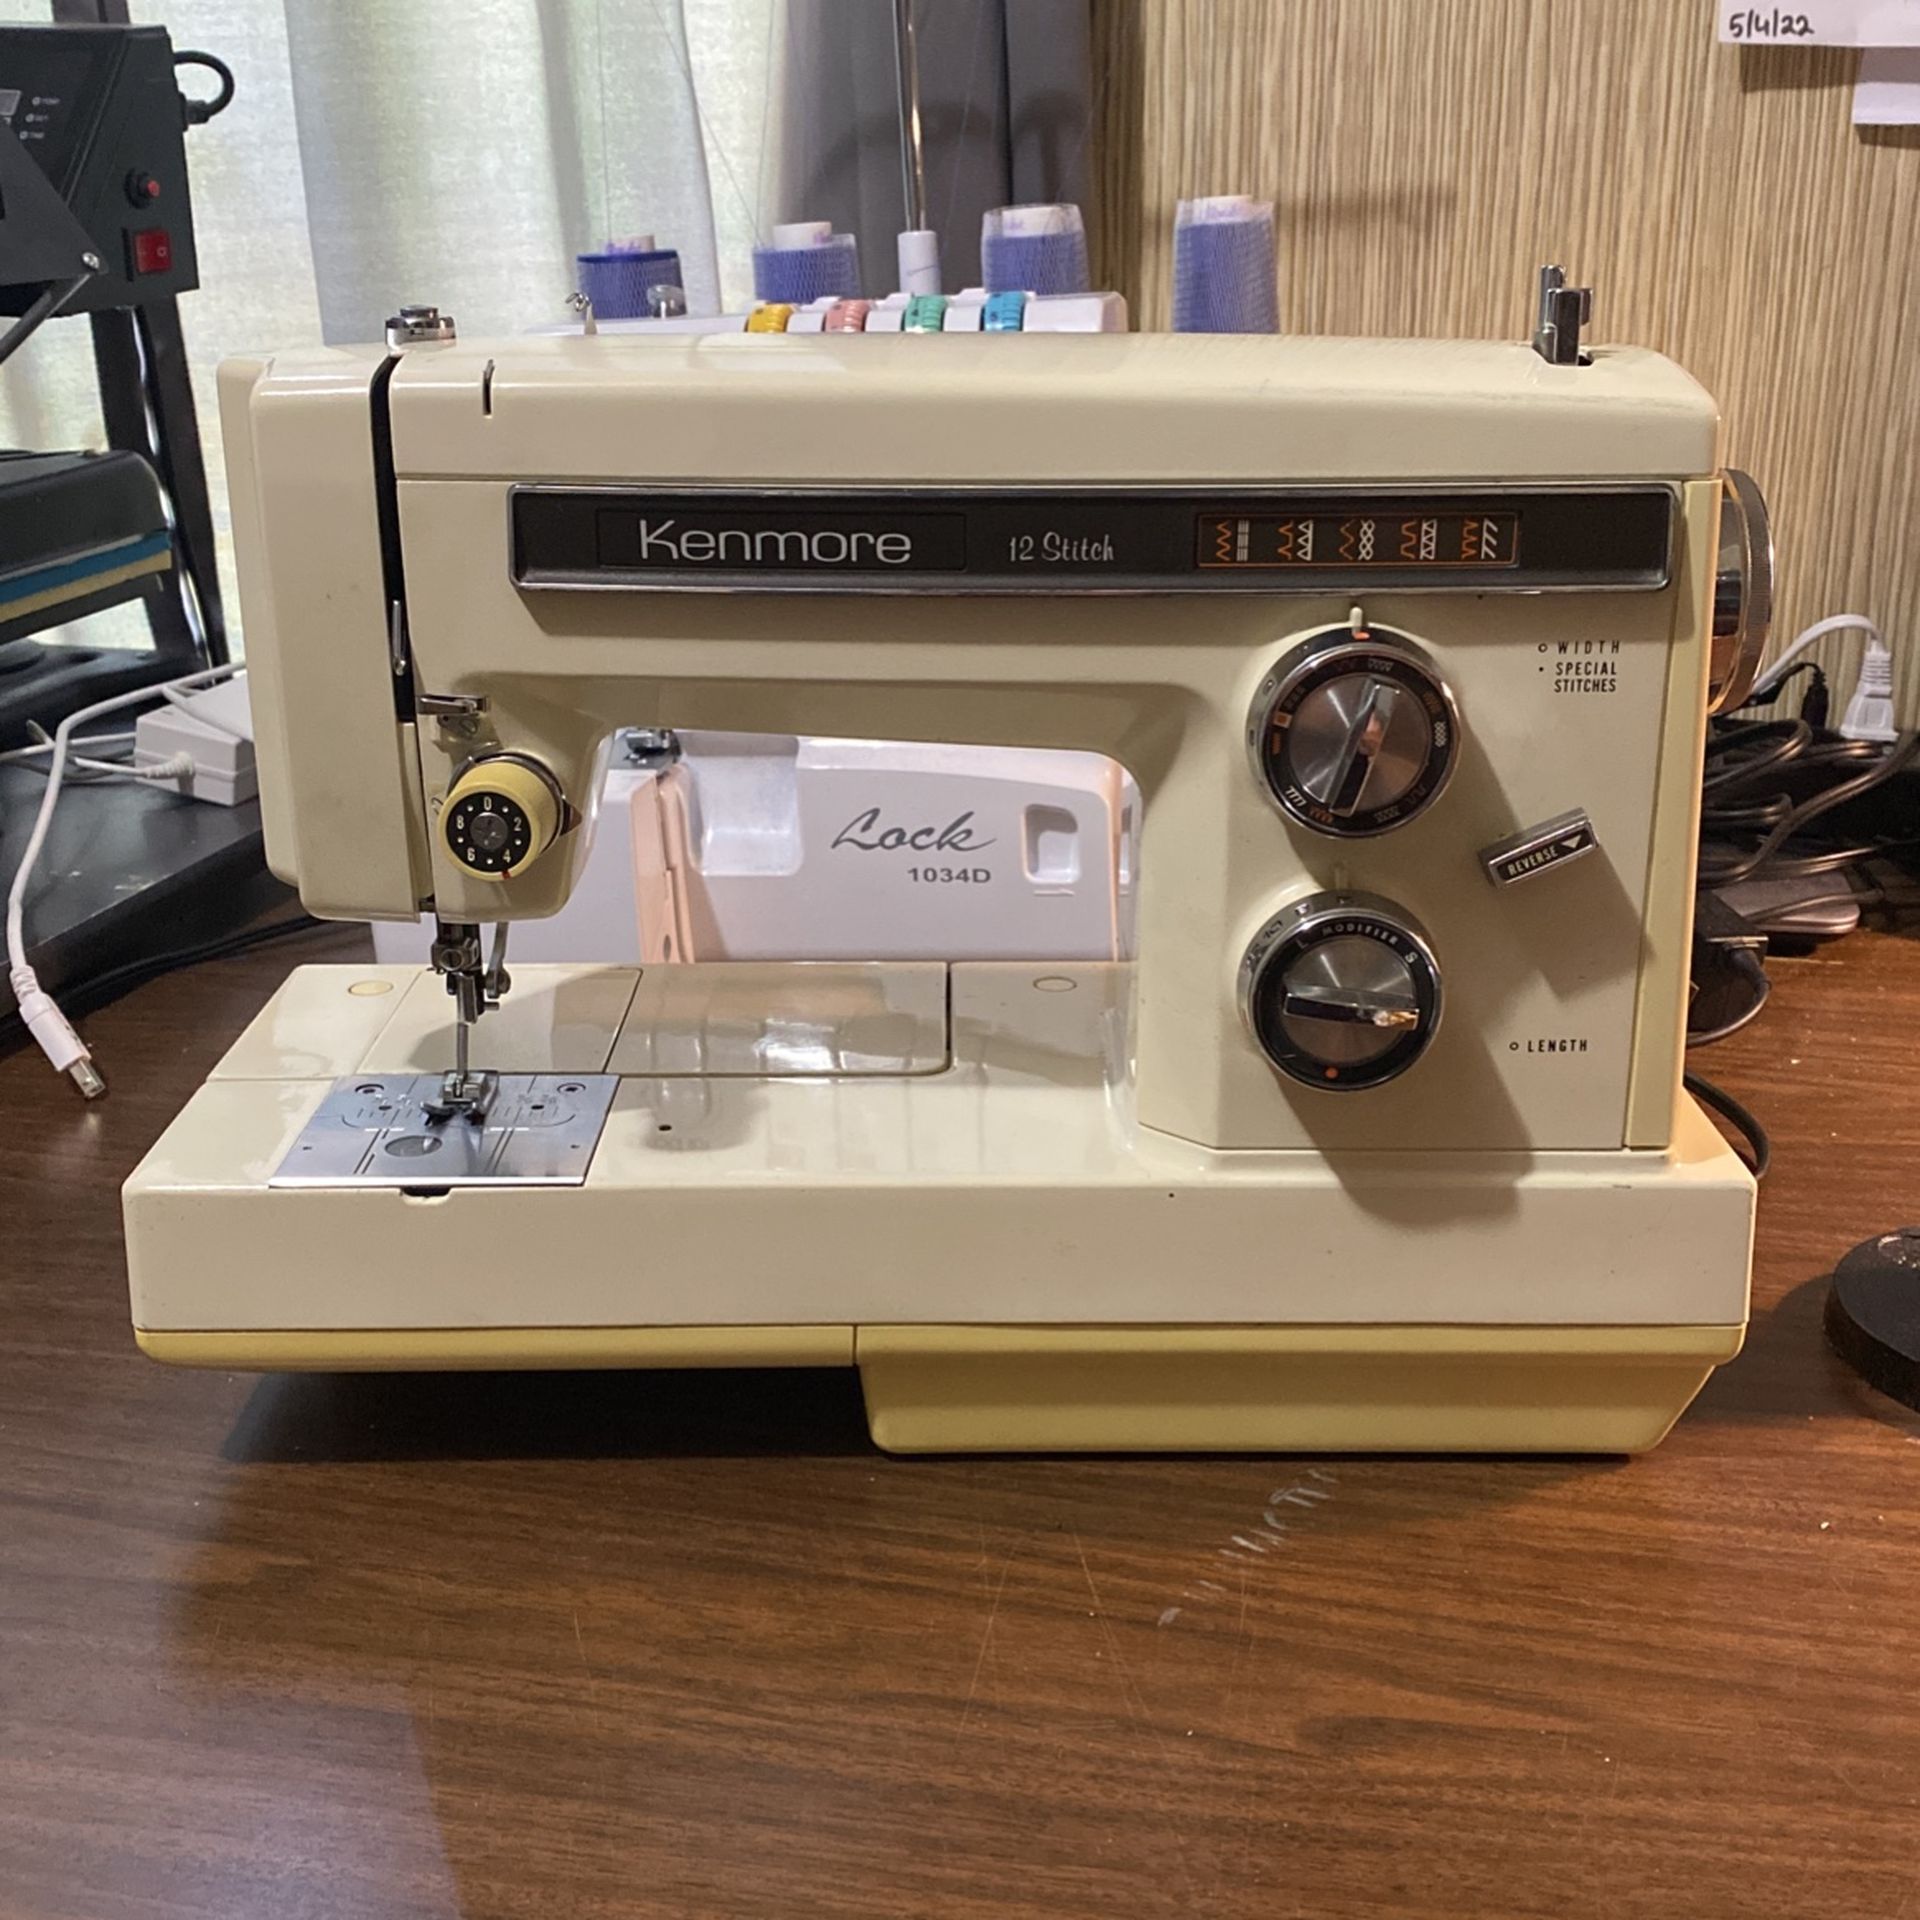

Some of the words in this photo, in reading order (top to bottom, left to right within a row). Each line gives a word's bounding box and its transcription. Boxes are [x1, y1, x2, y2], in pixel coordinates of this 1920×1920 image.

[1729, 8, 1815, 38] 5/4/22
[639, 519, 912, 564] Kenmore
[1009, 535, 1035, 562] 12
[1041, 531, 1114, 562] Stitch
[1557, 640, 1621, 655] WIDTH
[1555, 662, 1618, 676] SPECIAL
[1553, 678, 1617, 693] STITCHES
[455, 815, 465, 830] 8
[513, 817, 522, 832] 2
[830, 807, 998, 852] Lock
[466, 847, 476, 862] 6
[503, 849, 512, 863] 4
[1507, 845, 1559, 877] REVERSE
[907, 867, 992, 884] 1034D
[1321, 922, 1399, 946] MODIFIER
[1404, 951, 1418, 965] S
[1527, 1039, 1588, 1053] LENGTH
